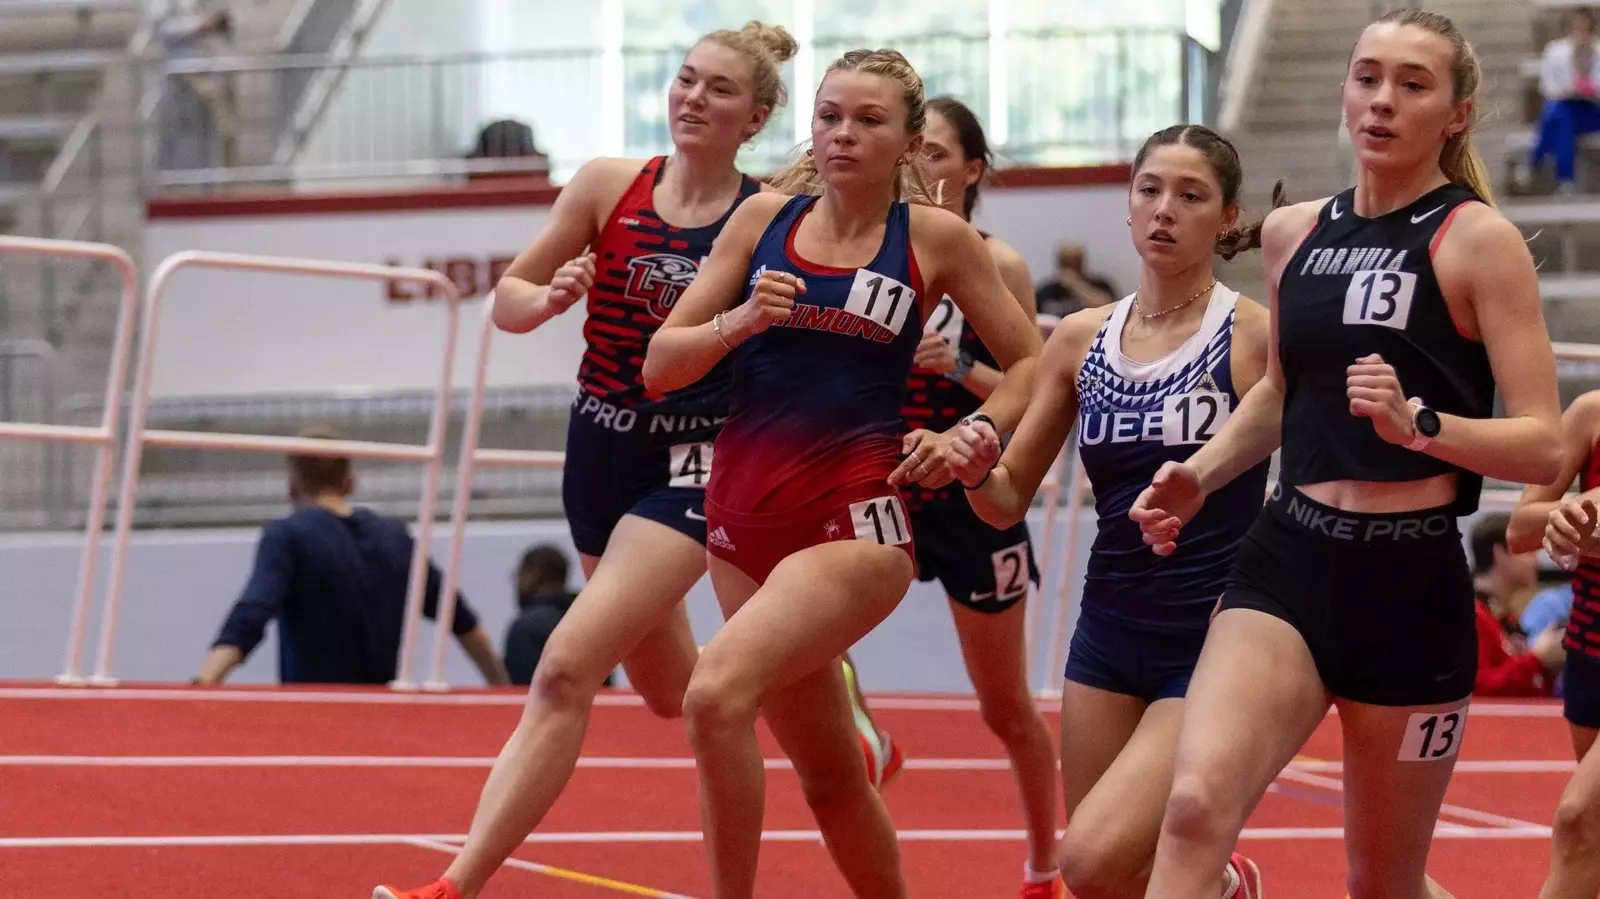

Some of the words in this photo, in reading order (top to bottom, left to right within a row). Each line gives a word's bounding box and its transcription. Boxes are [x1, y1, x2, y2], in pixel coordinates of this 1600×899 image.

[1300, 247, 1409, 276] FORMULA
[866, 276, 903, 326] 11
[1360, 273, 1402, 321] 13
[580, 396, 637, 432] PRO
[1078, 411, 1164, 446] UEE
[1175, 395, 1218, 442] 12
[679, 445, 712, 484] 4
[863, 498, 902, 544] 11
[1286, 497, 1359, 540] NIKE
[1364, 514, 1449, 541] PRO
[1002, 551, 1023, 594] 2
[1419, 712, 1459, 758] 13
